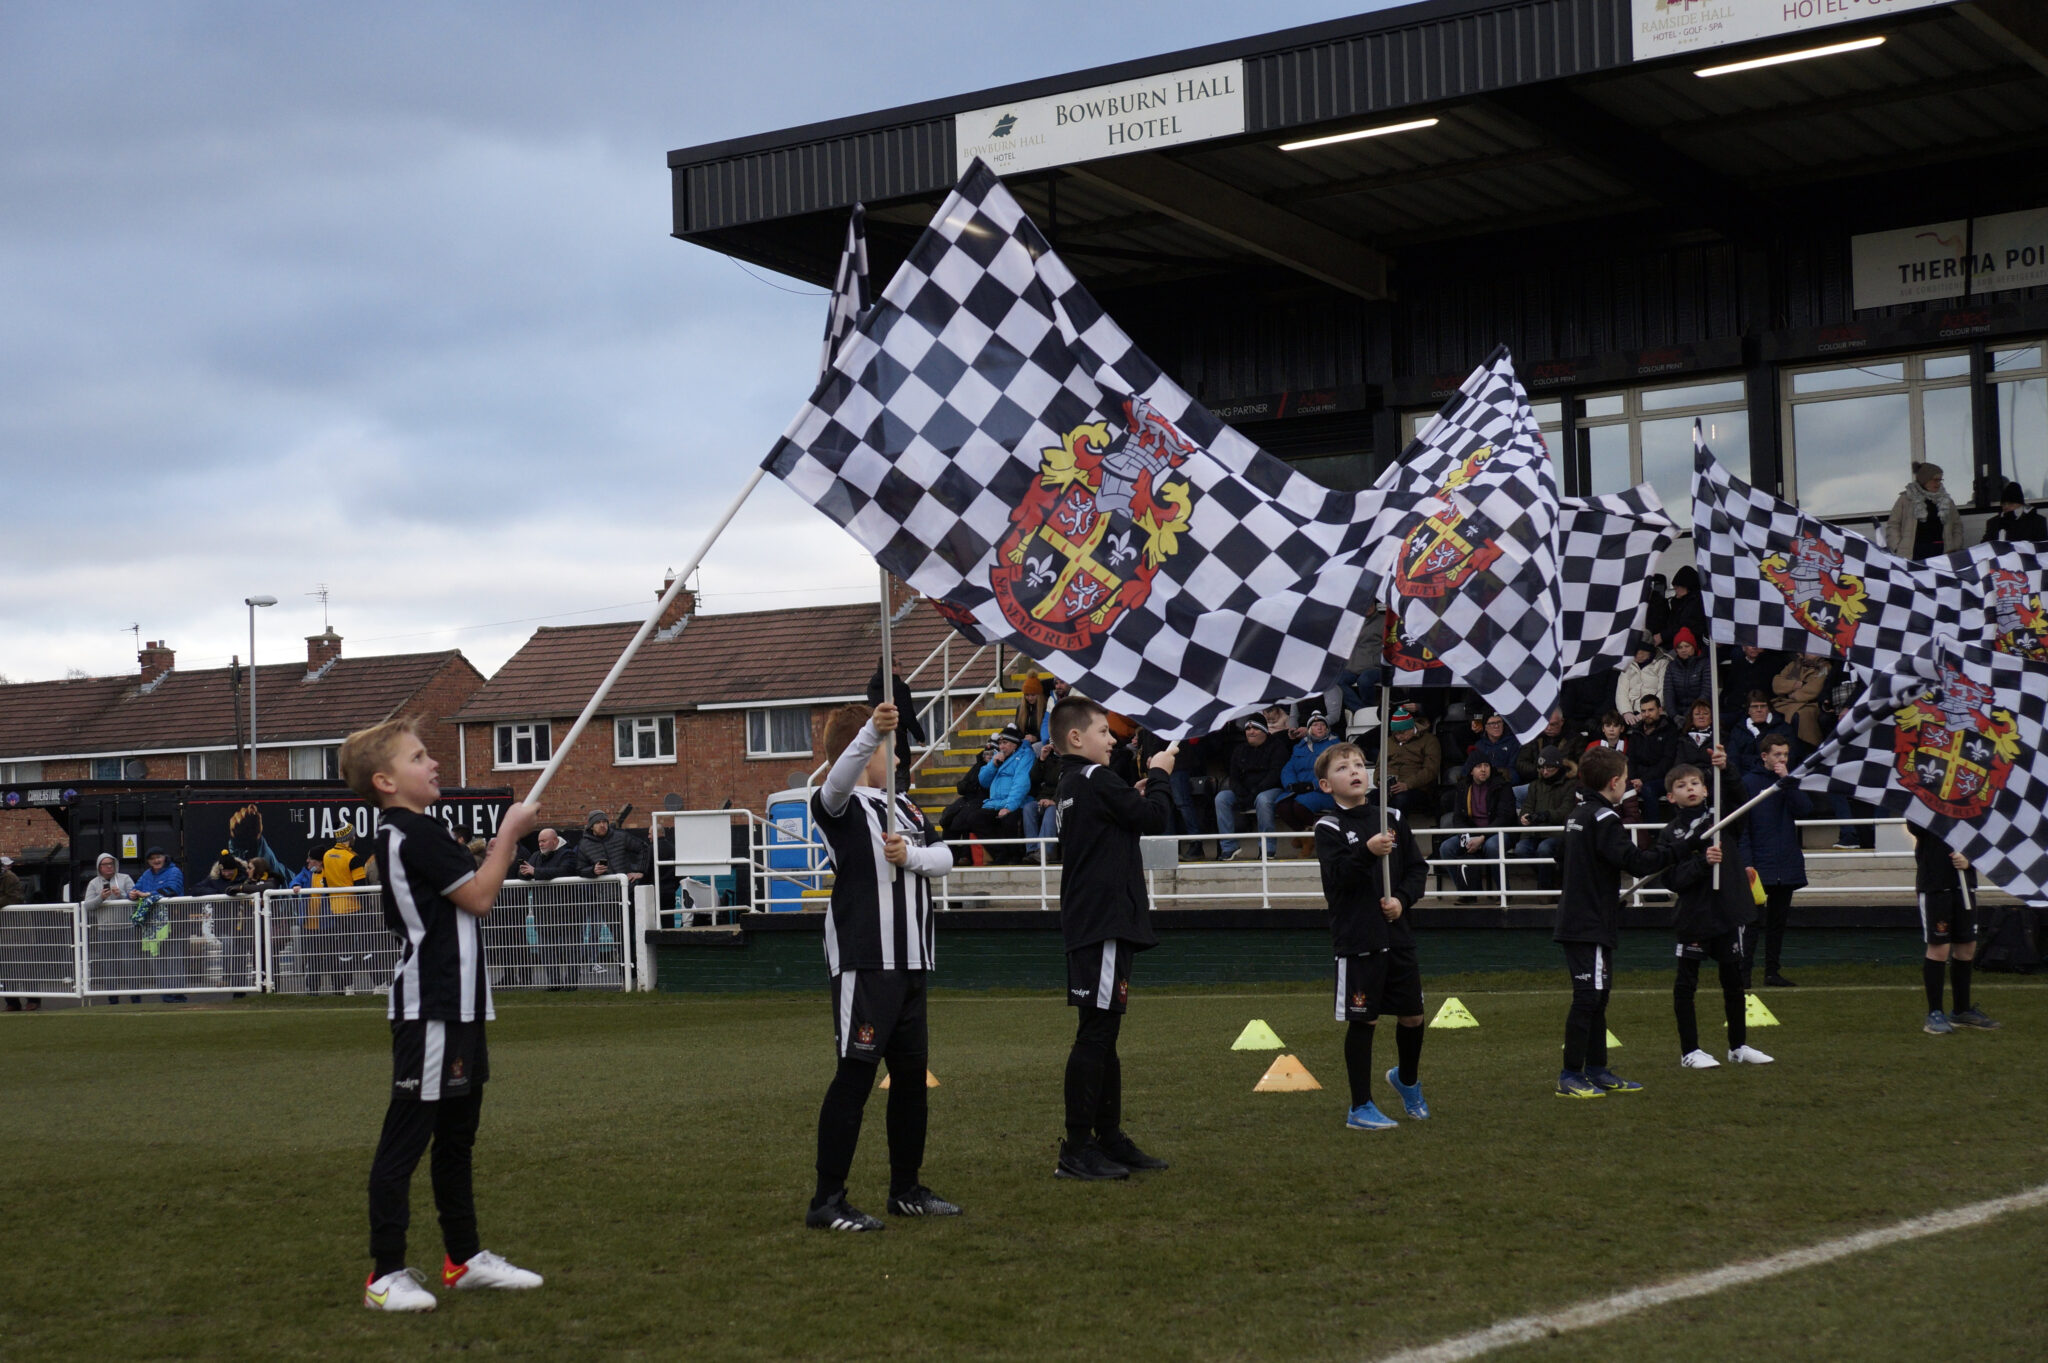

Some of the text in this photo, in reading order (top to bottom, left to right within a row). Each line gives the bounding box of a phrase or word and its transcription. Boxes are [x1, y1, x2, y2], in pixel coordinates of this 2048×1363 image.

[1783, 0, 1849, 21] HOTEL
[1641, 6, 1735, 33] RAMSIDE HALL
[1652, 22, 1723, 41] HOTEL GOLF SPA
[1055, 75, 1235, 126] BOWBURN HALL
[1108, 115, 1182, 146] HOTEL
[963, 133, 1046, 159] BOWBURN HALL
[993, 152, 1016, 162] HOTEL
[1940, 324, 1991, 337] COLOUR PRINT
[1818, 342, 1847, 351] COLOUR
[1638, 364, 1665, 374] COLOUR
[1533, 376, 1560, 386] COLOUR
[1233, 403, 1268, 416] PARTNER
[1043, 631, 1084, 648] RUET
[289, 808, 305, 824] THE
